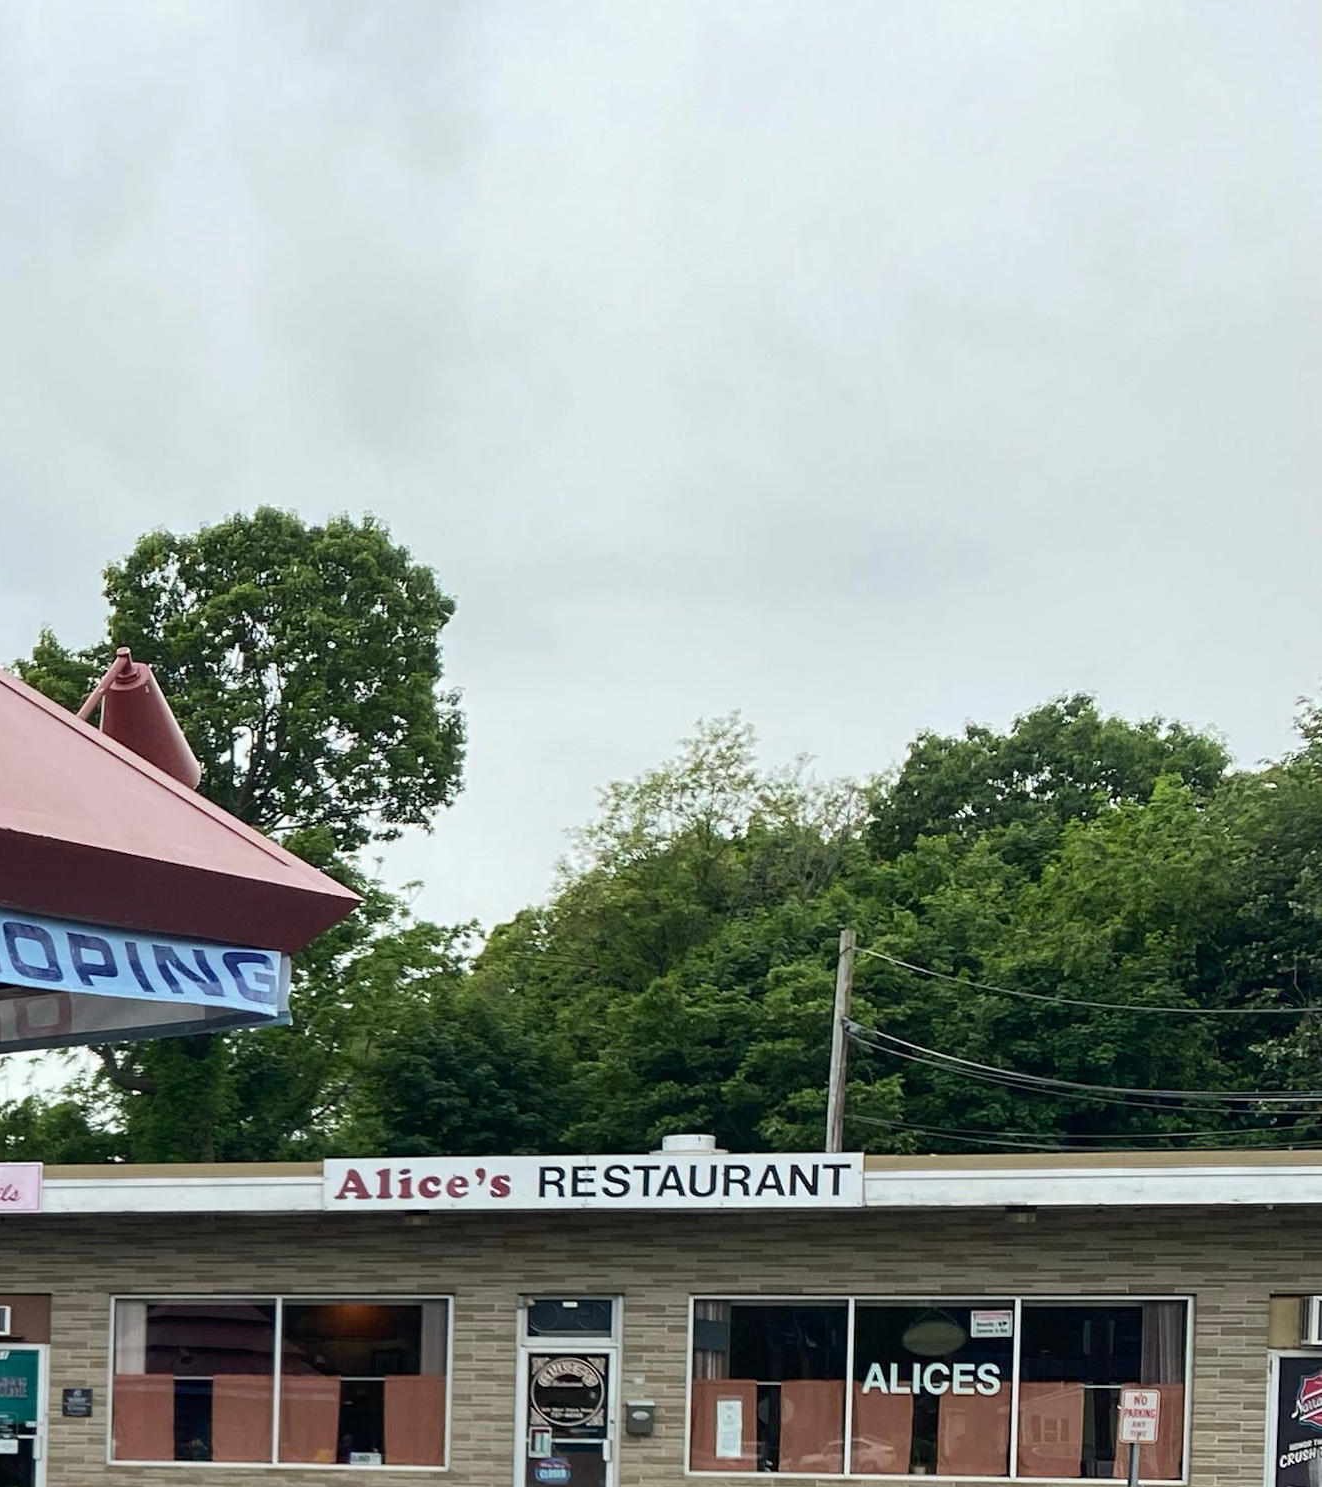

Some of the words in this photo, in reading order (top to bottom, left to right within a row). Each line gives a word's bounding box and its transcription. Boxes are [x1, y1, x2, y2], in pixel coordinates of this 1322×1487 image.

[334, 1167, 512, 1200] Alice's
[538, 1163, 852, 1199] RESTAURANT
[862, 1362, 1002, 1397] ALICES
[1133, 1395, 1149, 1406] NO
[1123, 1408, 1157, 1419] PARKING
[1131, 1420, 1147, 1429] ANY
[1279, 1446, 1317, 1469] CRUSH
